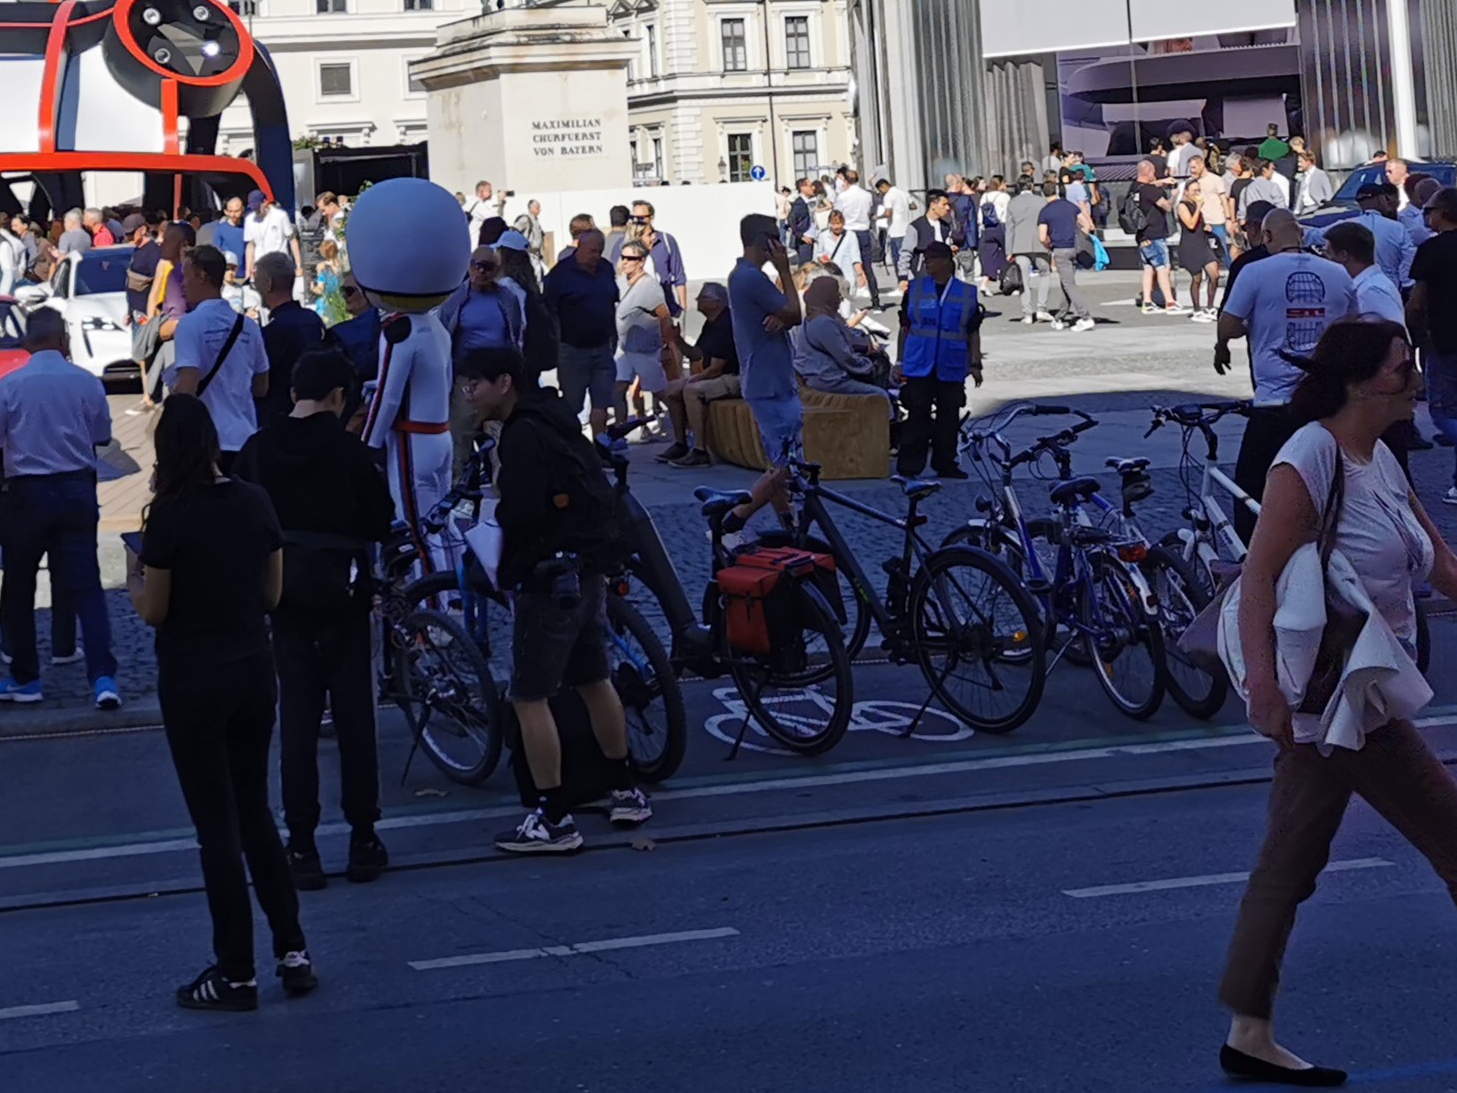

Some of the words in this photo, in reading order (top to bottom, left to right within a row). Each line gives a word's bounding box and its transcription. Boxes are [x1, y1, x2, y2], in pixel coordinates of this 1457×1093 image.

[532, 118, 601, 129] MAXIMILIAN
[532, 132, 601, 143] CHURFUERST
[533, 147, 555, 156] VON
[560, 145, 602, 155] BAYERN
